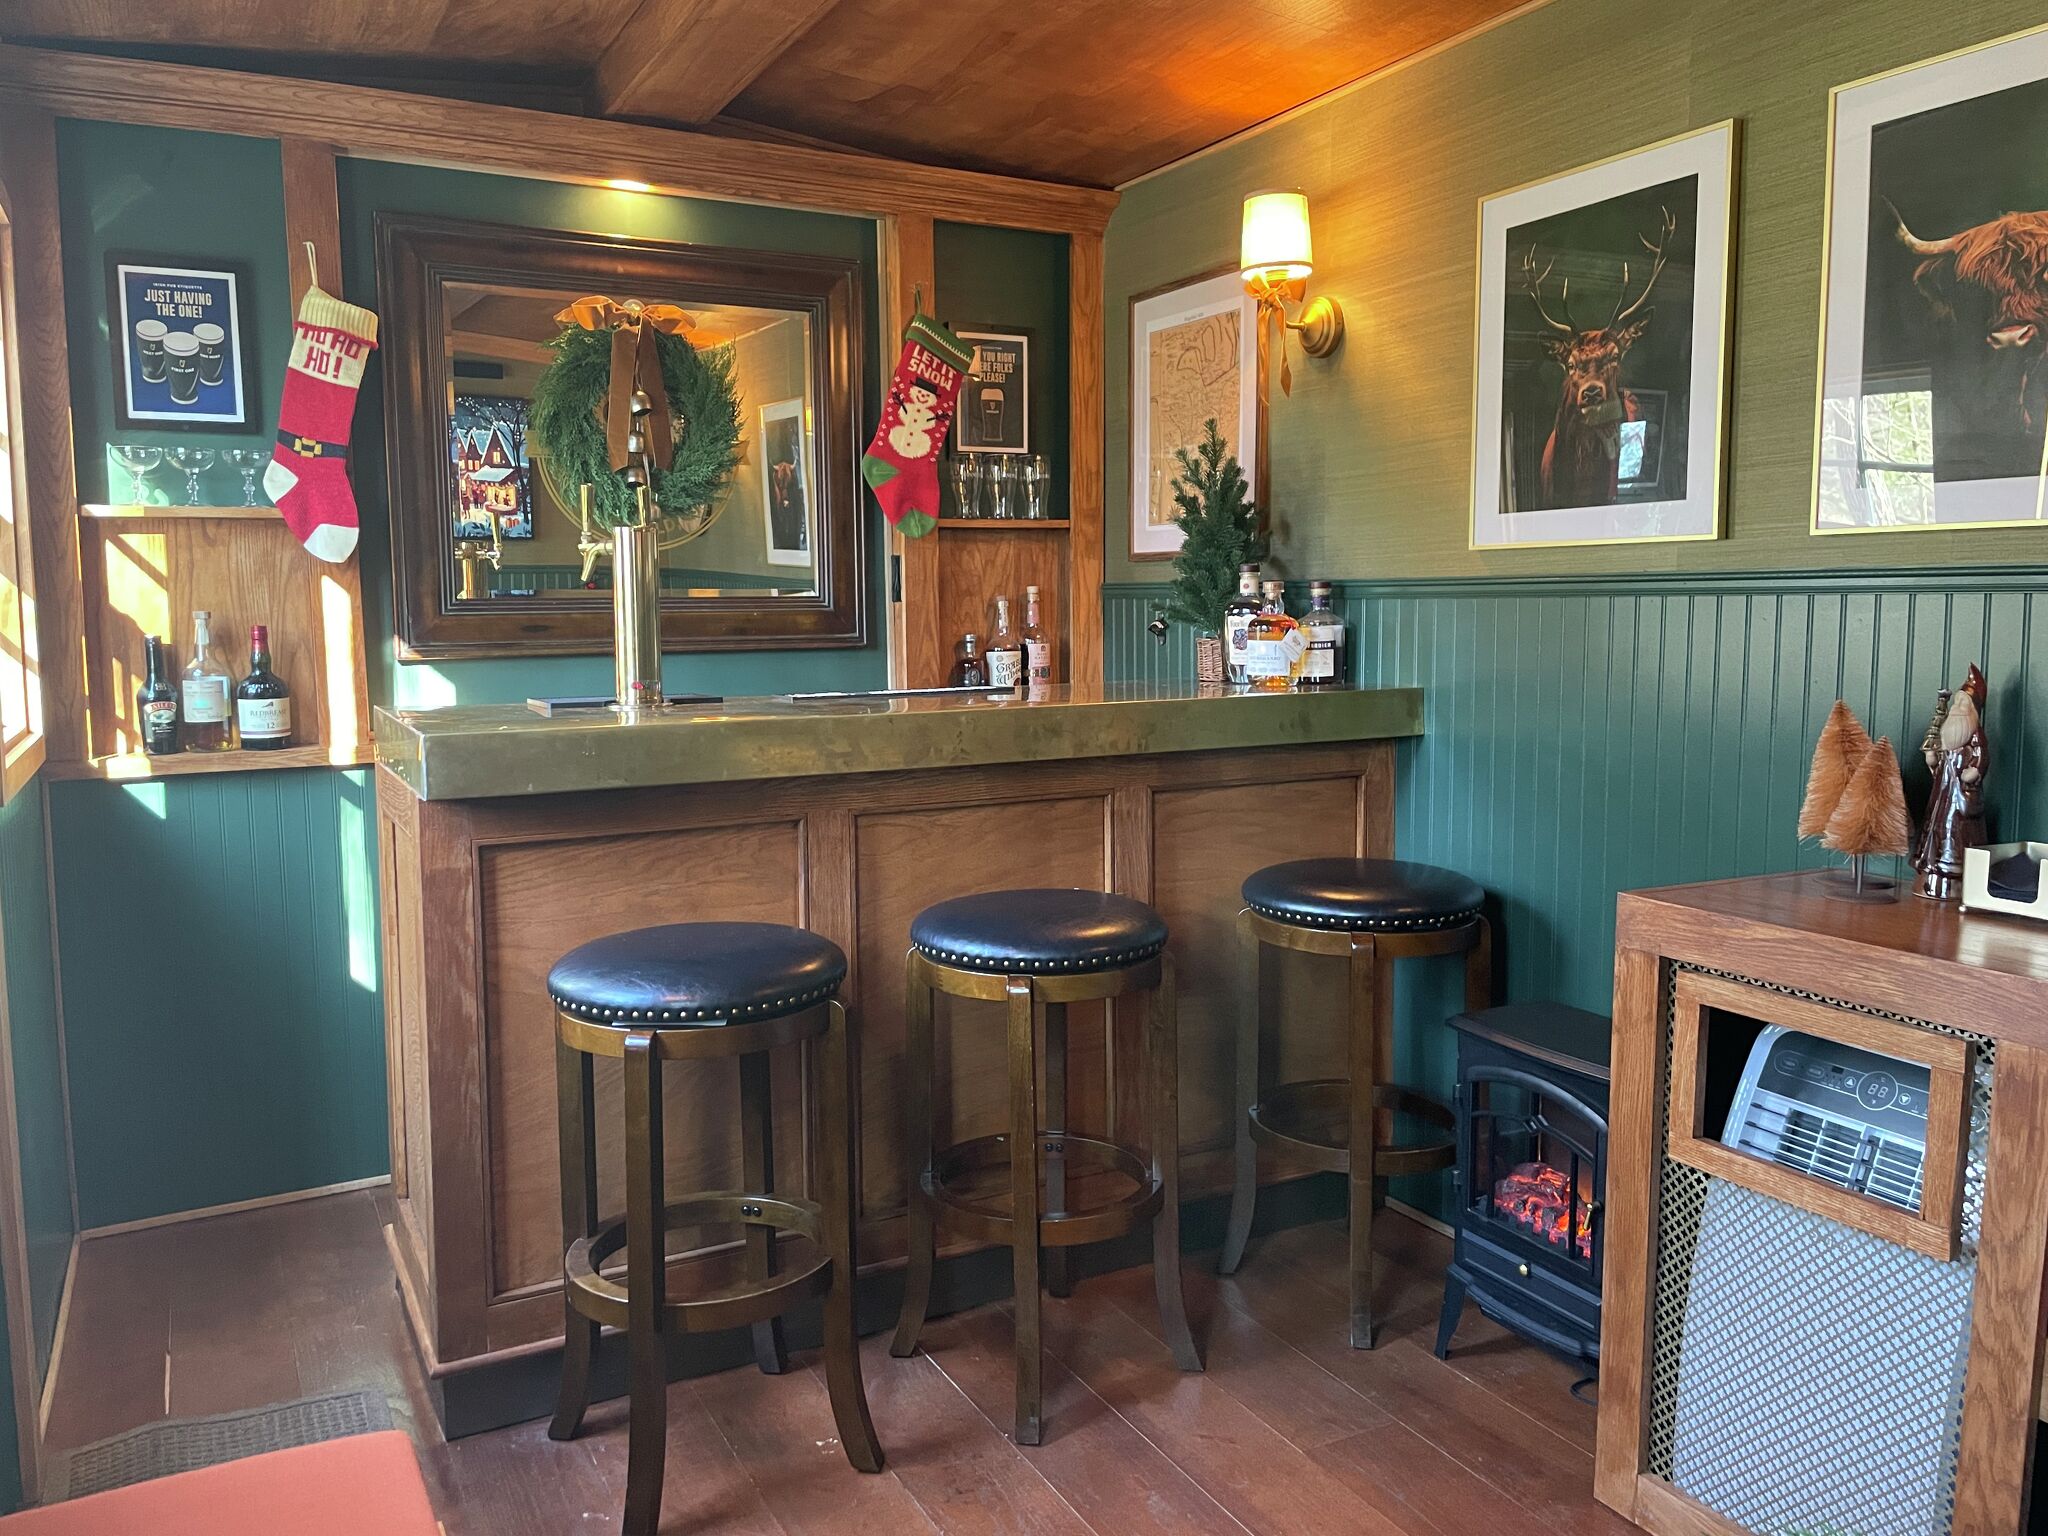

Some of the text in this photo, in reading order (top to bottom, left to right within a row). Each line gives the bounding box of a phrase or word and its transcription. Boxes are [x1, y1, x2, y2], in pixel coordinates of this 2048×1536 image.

[144, 288, 212, 306] JUST HAVING
[155, 302, 203, 318] THE ONE!
[911, 343, 957, 379] LET IT
[983, 350, 1017, 364] YOU RIGHT
[907, 358, 953, 391] SNOW
[993, 362, 1013, 374] FOLKS
